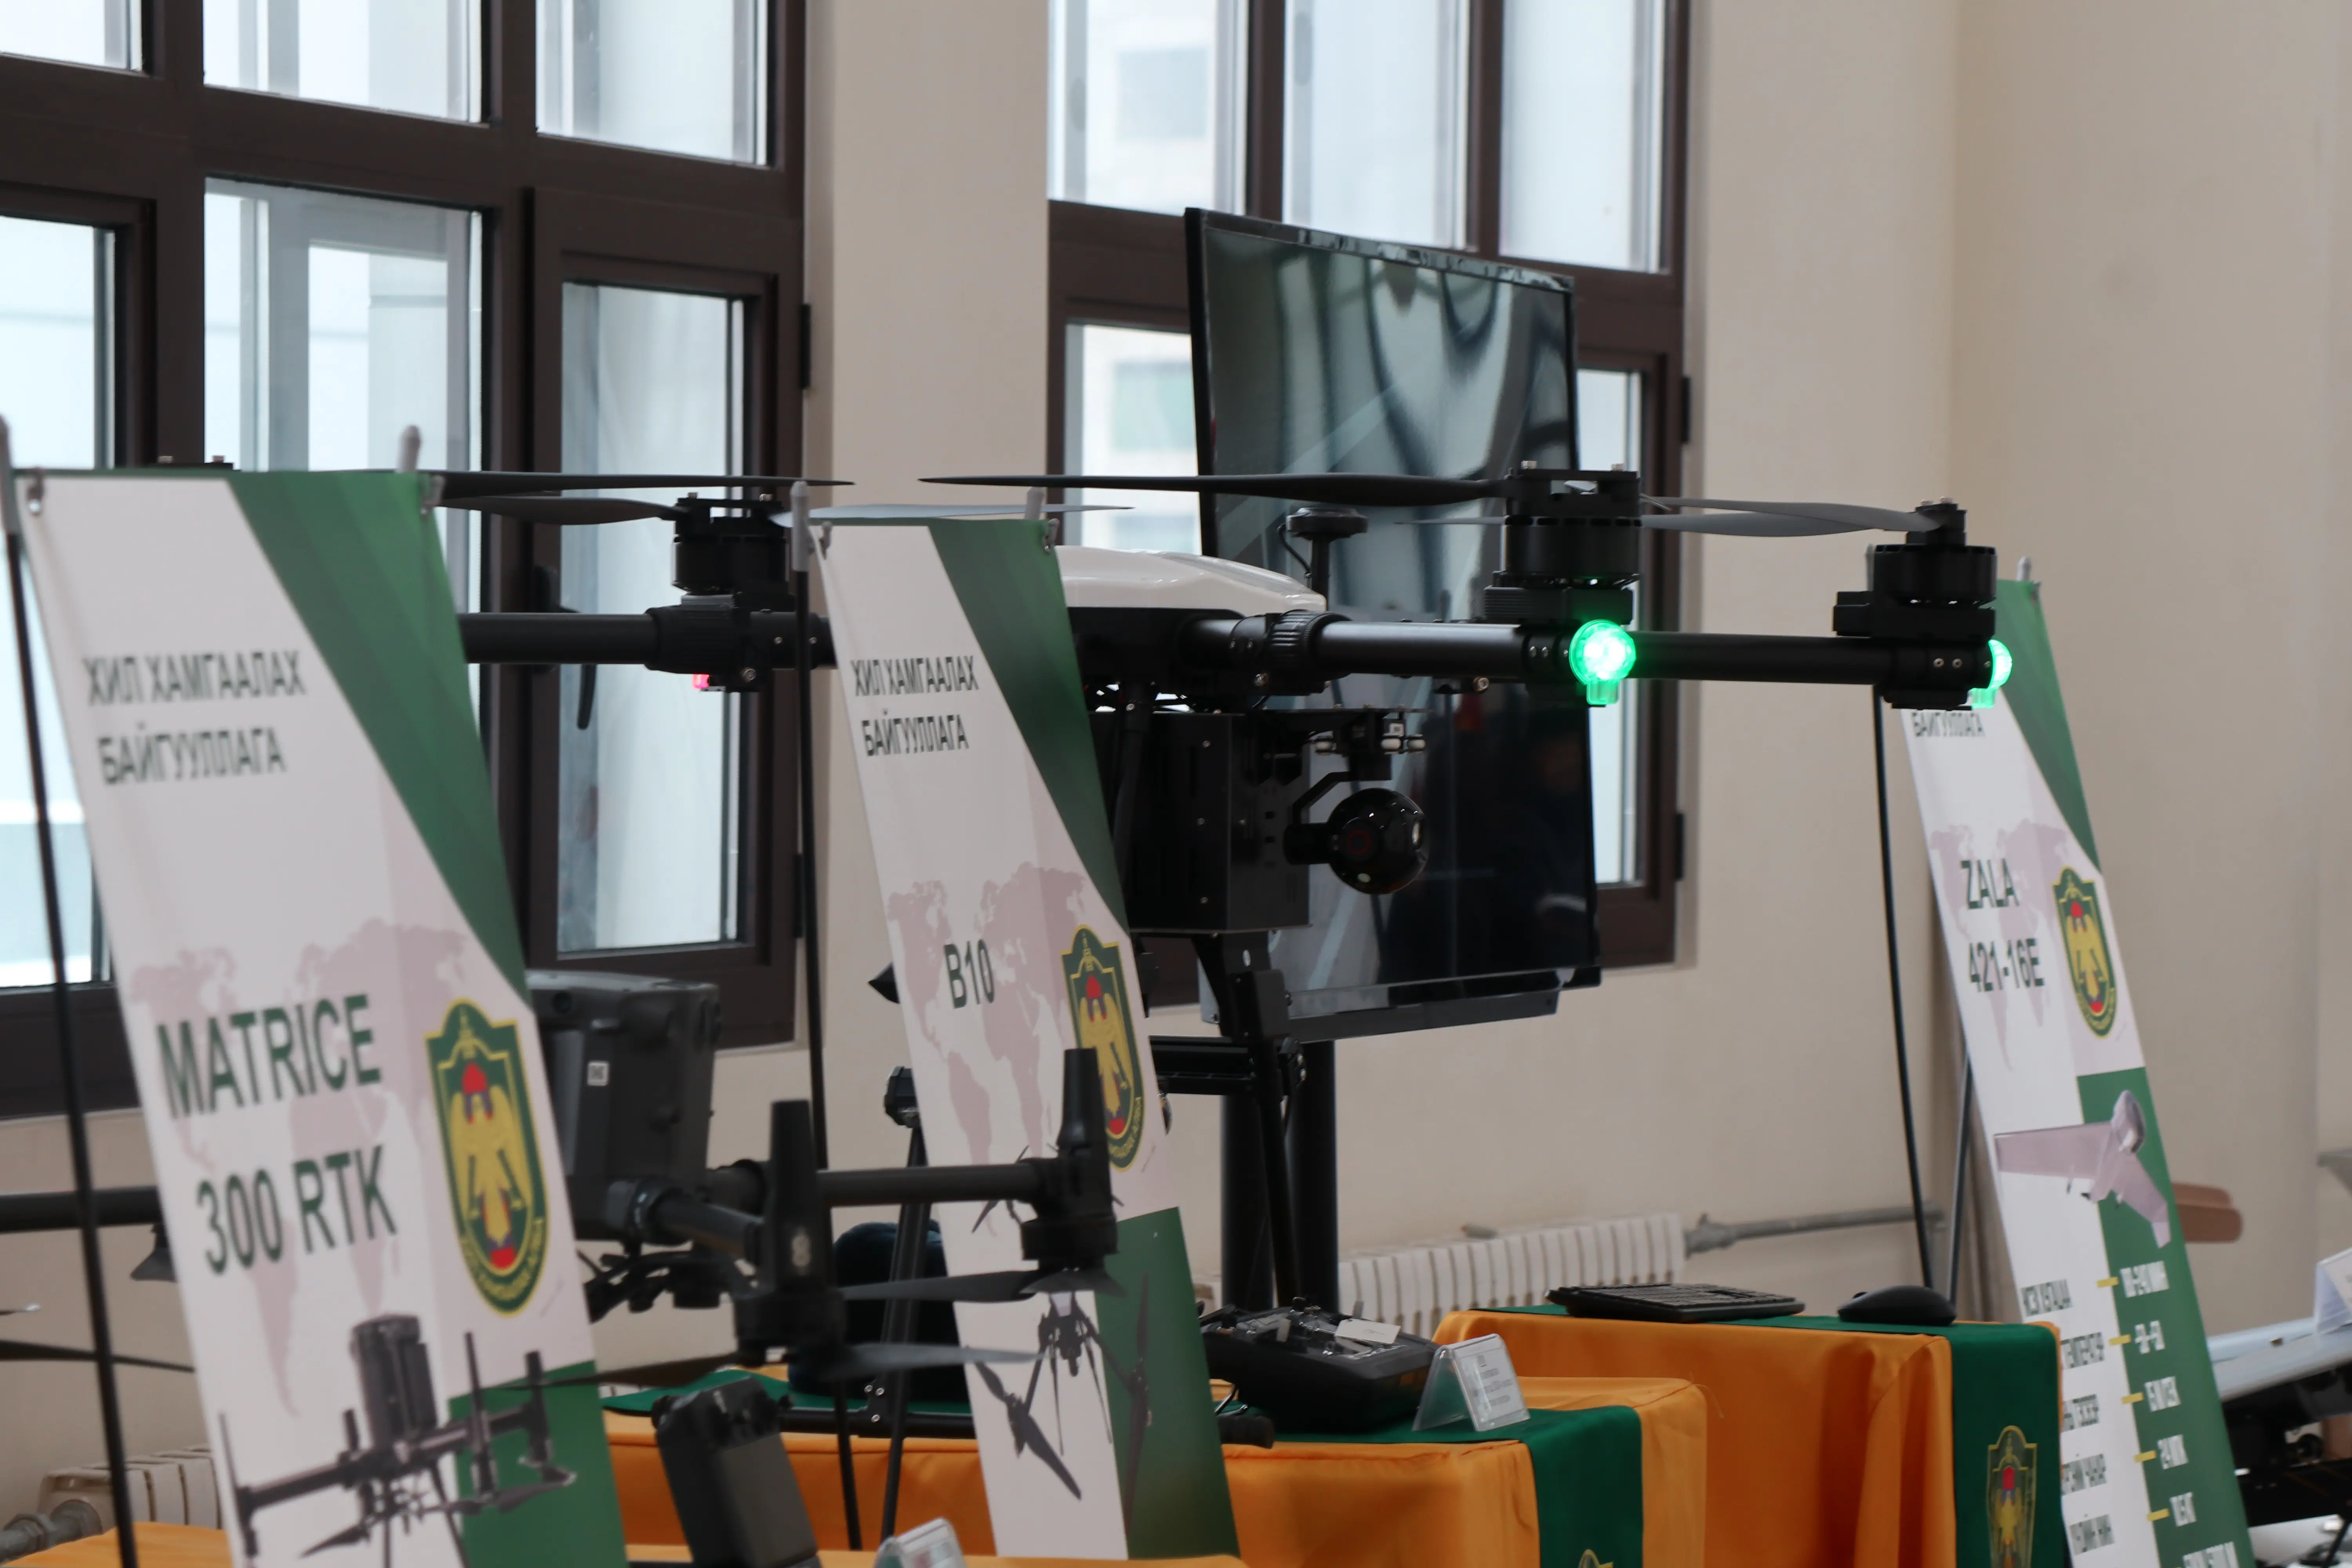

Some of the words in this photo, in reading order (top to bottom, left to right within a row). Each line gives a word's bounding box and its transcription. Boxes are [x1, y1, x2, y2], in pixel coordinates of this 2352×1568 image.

[84, 656, 143, 706] ХИЛ
[148, 650, 305, 702] ХАМГААЛАХ
[851, 660, 883, 696] ХИЛ
[884, 655, 979, 695] ХАМГААЛАХ
[98, 722, 285, 784] БАЙГУУЛЛАГА
[861, 710, 969, 757] БАЙГУУЛЛАГА
[1960, 858, 2020, 910] ZALA
[944, 938, 996, 1009] B10
[1969, 938, 2045, 992] 421-16E
[157, 994, 382, 1120] MATRICE
[196, 1167, 283, 1276] 300
[292, 1145, 397, 1255] RTK
